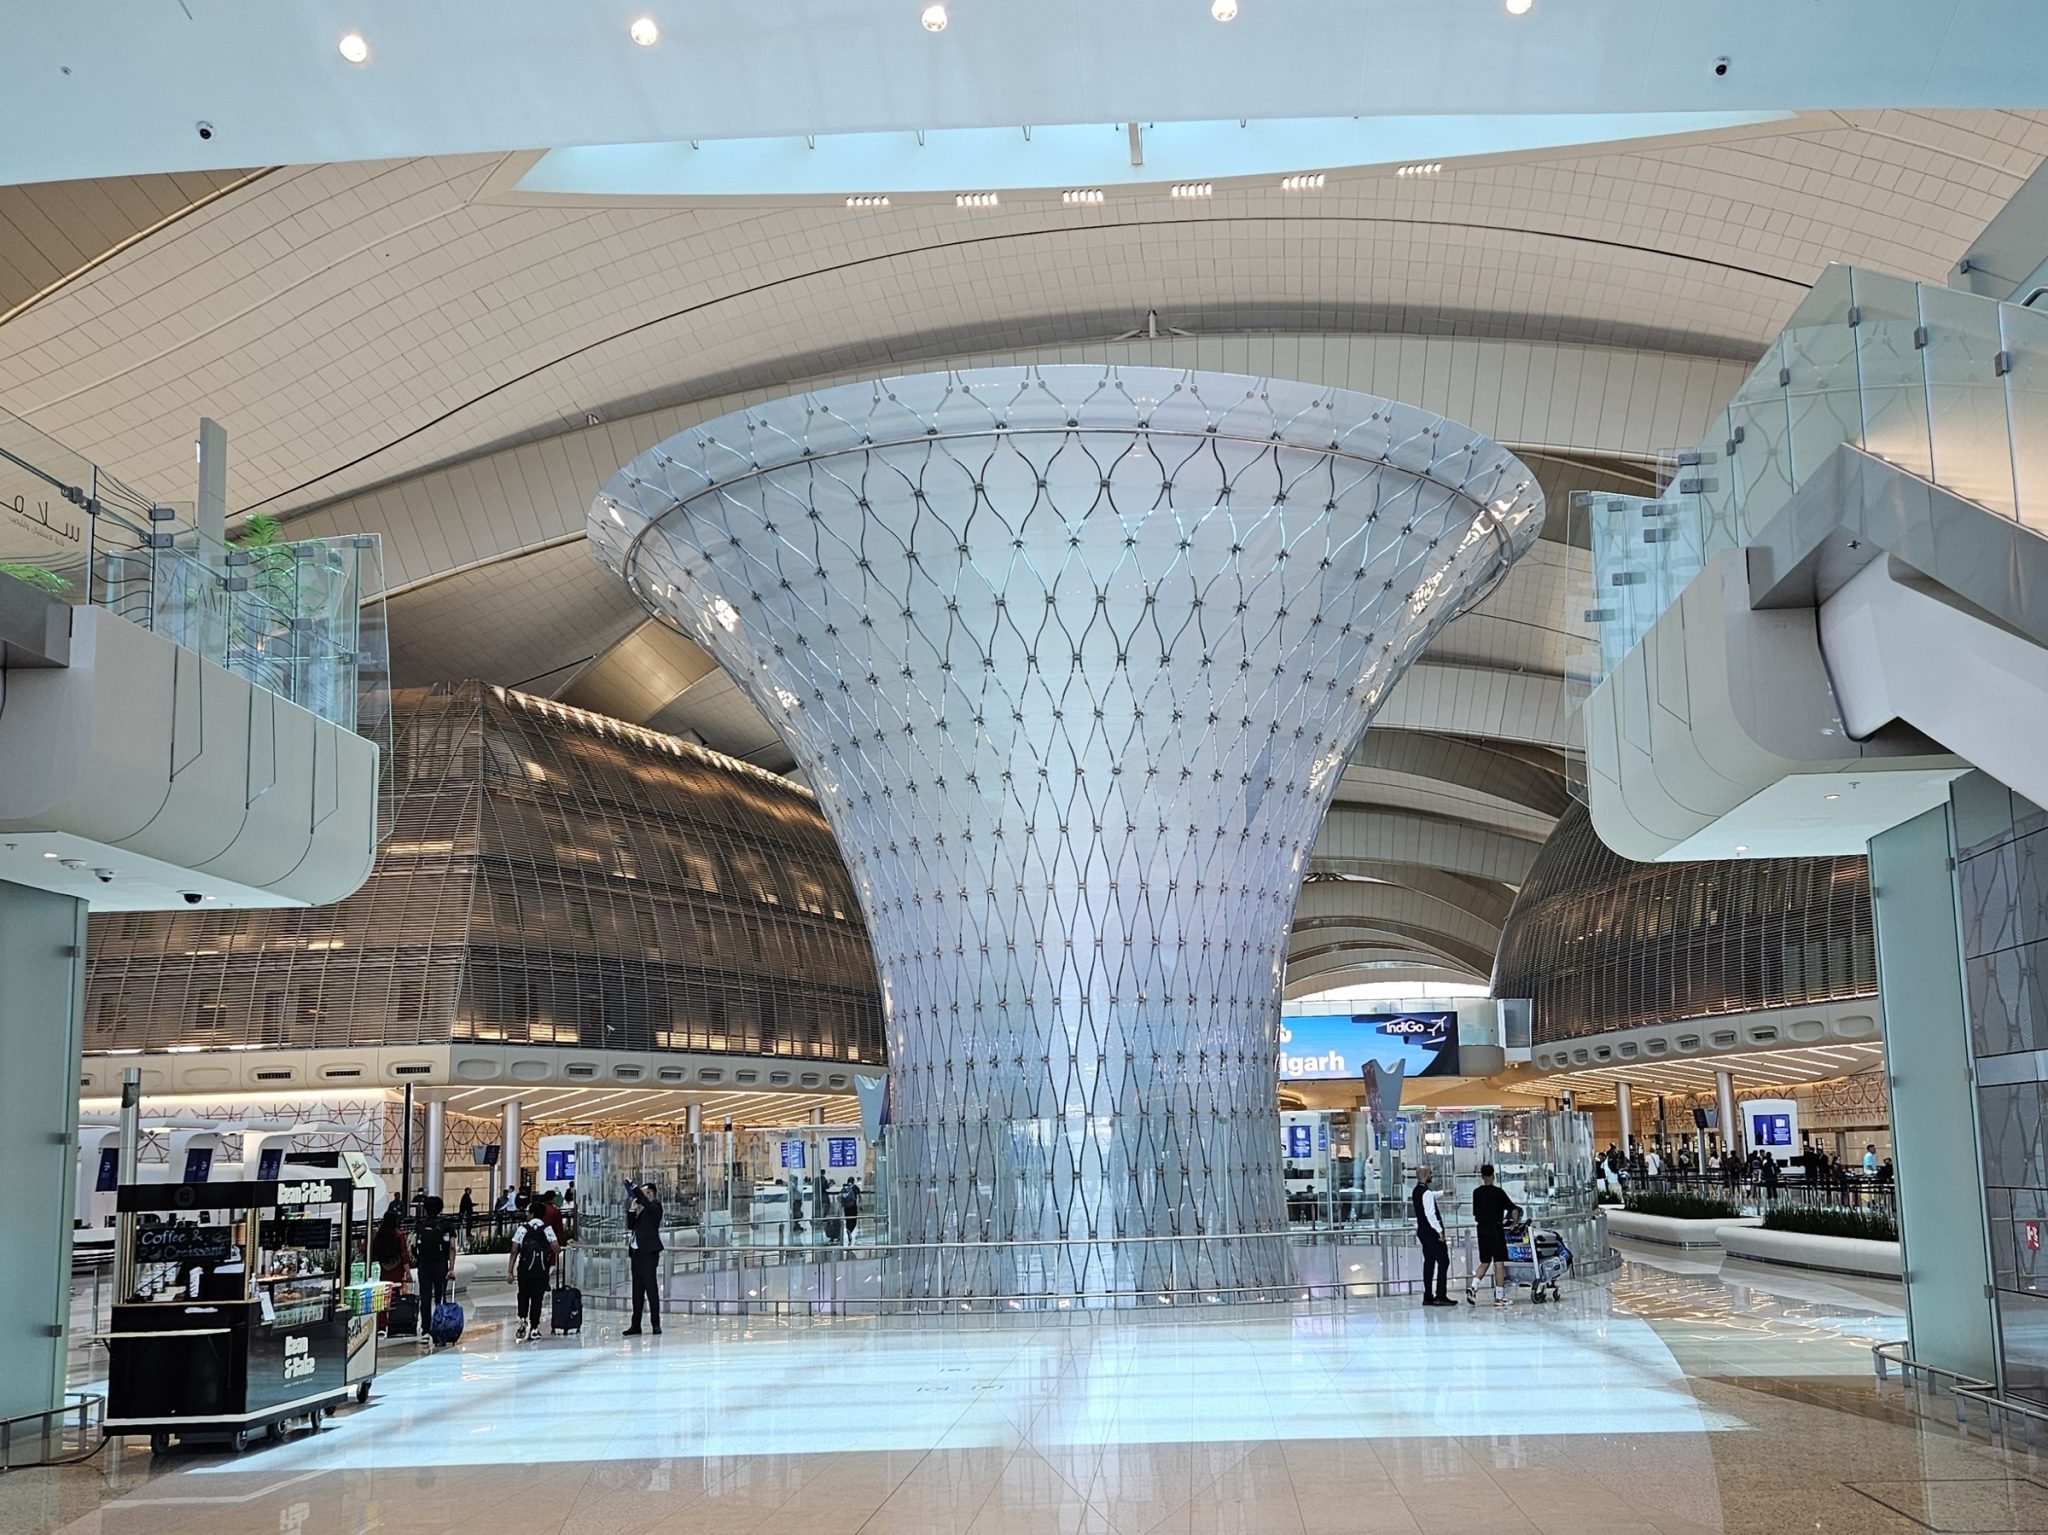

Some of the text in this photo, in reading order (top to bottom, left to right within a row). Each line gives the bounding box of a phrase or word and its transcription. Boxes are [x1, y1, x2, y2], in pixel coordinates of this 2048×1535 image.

[1386, 1020, 1424, 1033] IndiGo
[141, 1229, 203, 1245] Coffee &
[284, 1335, 308, 1356] Bean
